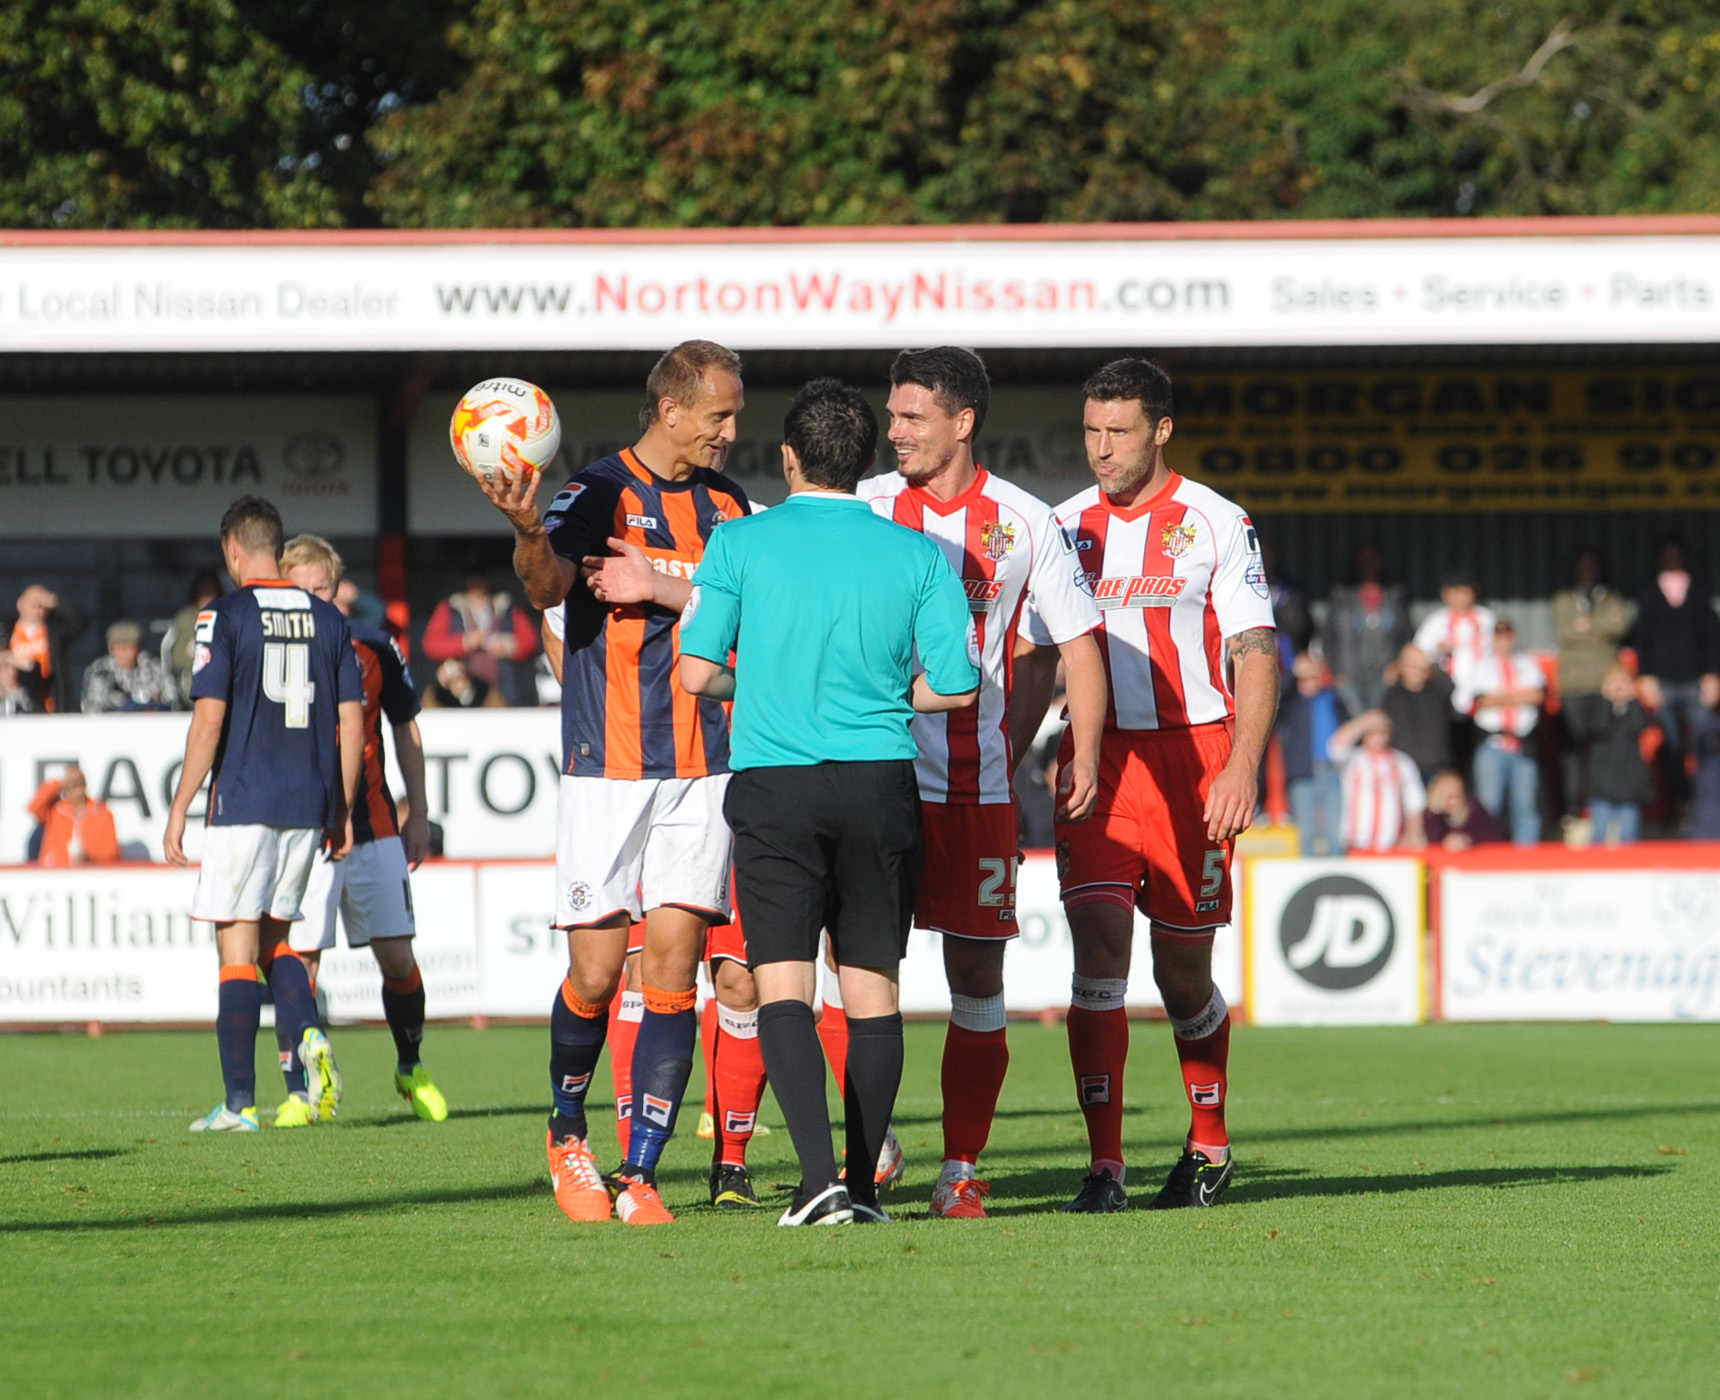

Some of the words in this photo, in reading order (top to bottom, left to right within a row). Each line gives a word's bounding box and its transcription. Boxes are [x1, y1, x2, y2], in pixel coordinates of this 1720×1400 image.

[18, 286, 118, 318] Local
[135, 285, 262, 317] Nissan
[277, 283, 397, 318] Dealer
[1271, 278, 1377, 312] Sales
[1422, 276, 1566, 311] Service
[1609, 274, 1710, 307] Parts
[474, 381, 527, 398] mitre
[1172, 377, 1551, 416] MORGAN
[77, 448, 263, 486] TOYOTA
[1200, 444, 1404, 474] 0800
[1437, 441, 1584, 472] 026
[628, 517, 654, 527] FILA
[260, 612, 315, 638] SMITH
[263, 643, 315, 728] 4
[1201, 849, 1227, 897] 5
[1198, 902, 1218, 911] FILA
[1288, 895, 1390, 969] JD
